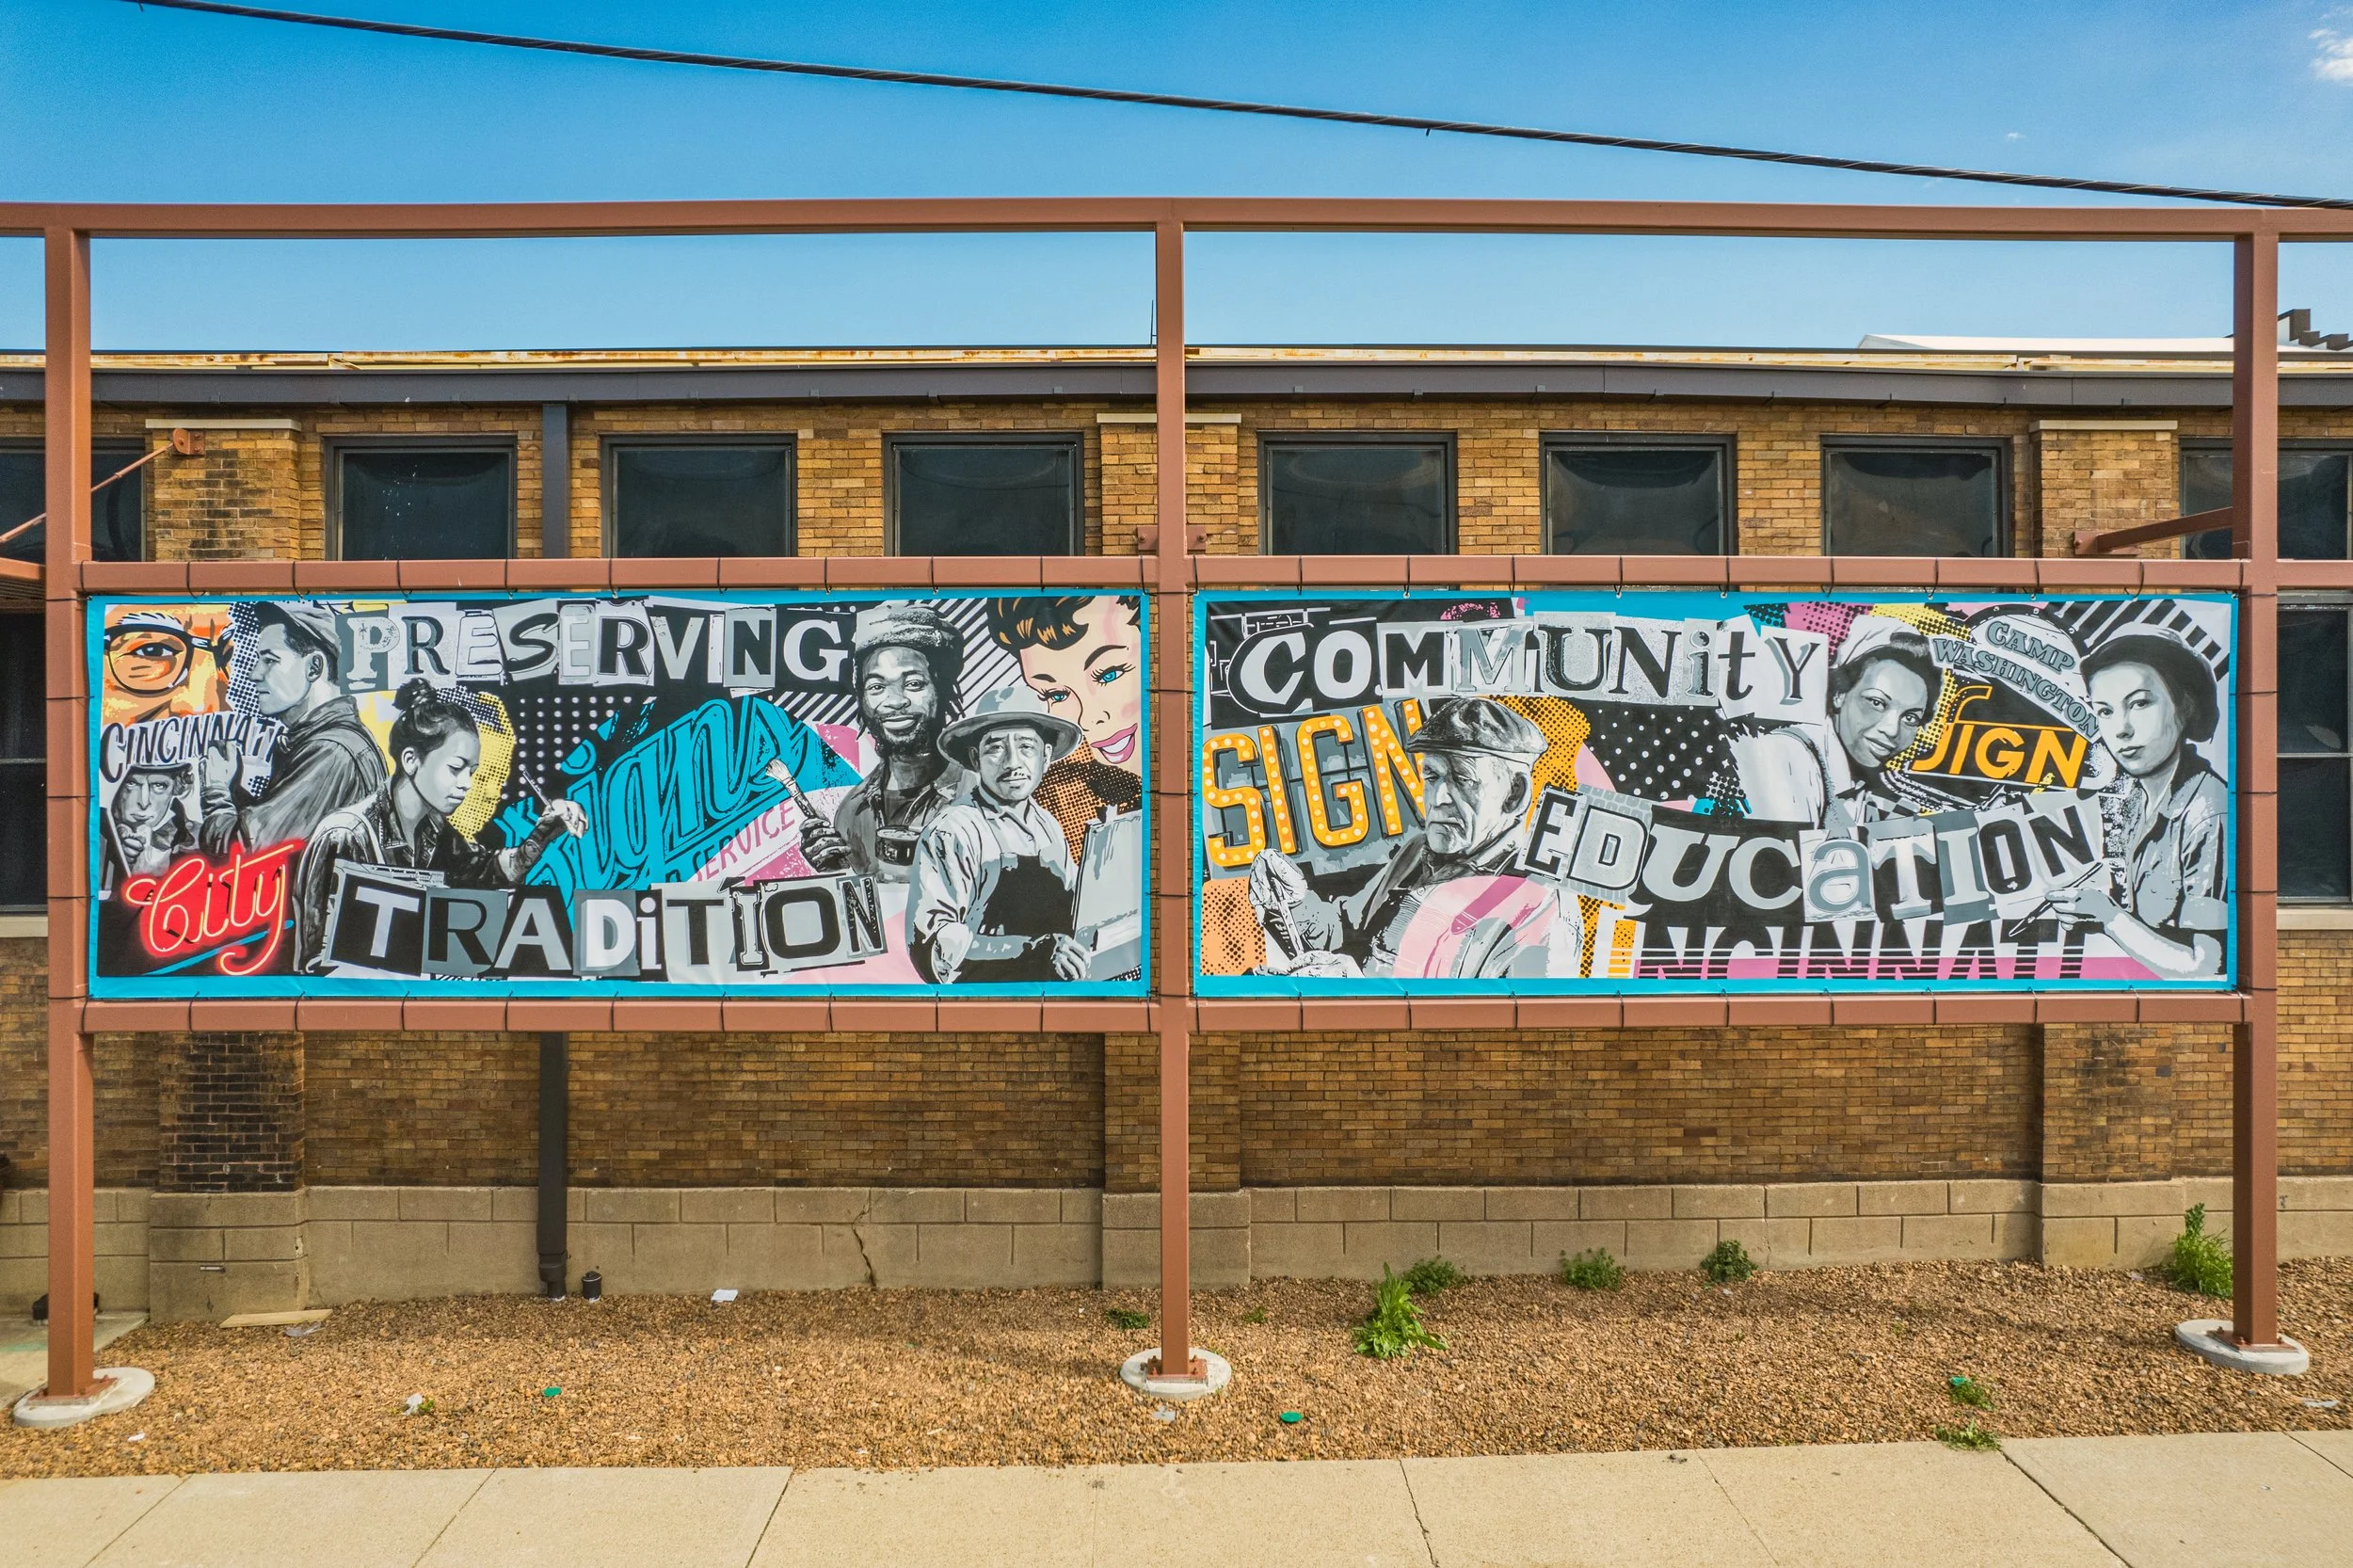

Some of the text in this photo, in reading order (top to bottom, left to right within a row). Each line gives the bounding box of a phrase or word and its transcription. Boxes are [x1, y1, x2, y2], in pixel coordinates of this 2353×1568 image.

[346, 604, 849, 691] PRESERVING
[1933, 637, 2100, 739] WASHINGTON
[1985, 620, 2075, 675] CAMP
[1203, 697, 1425, 868] SIGN
[126, 843, 295, 976] City
